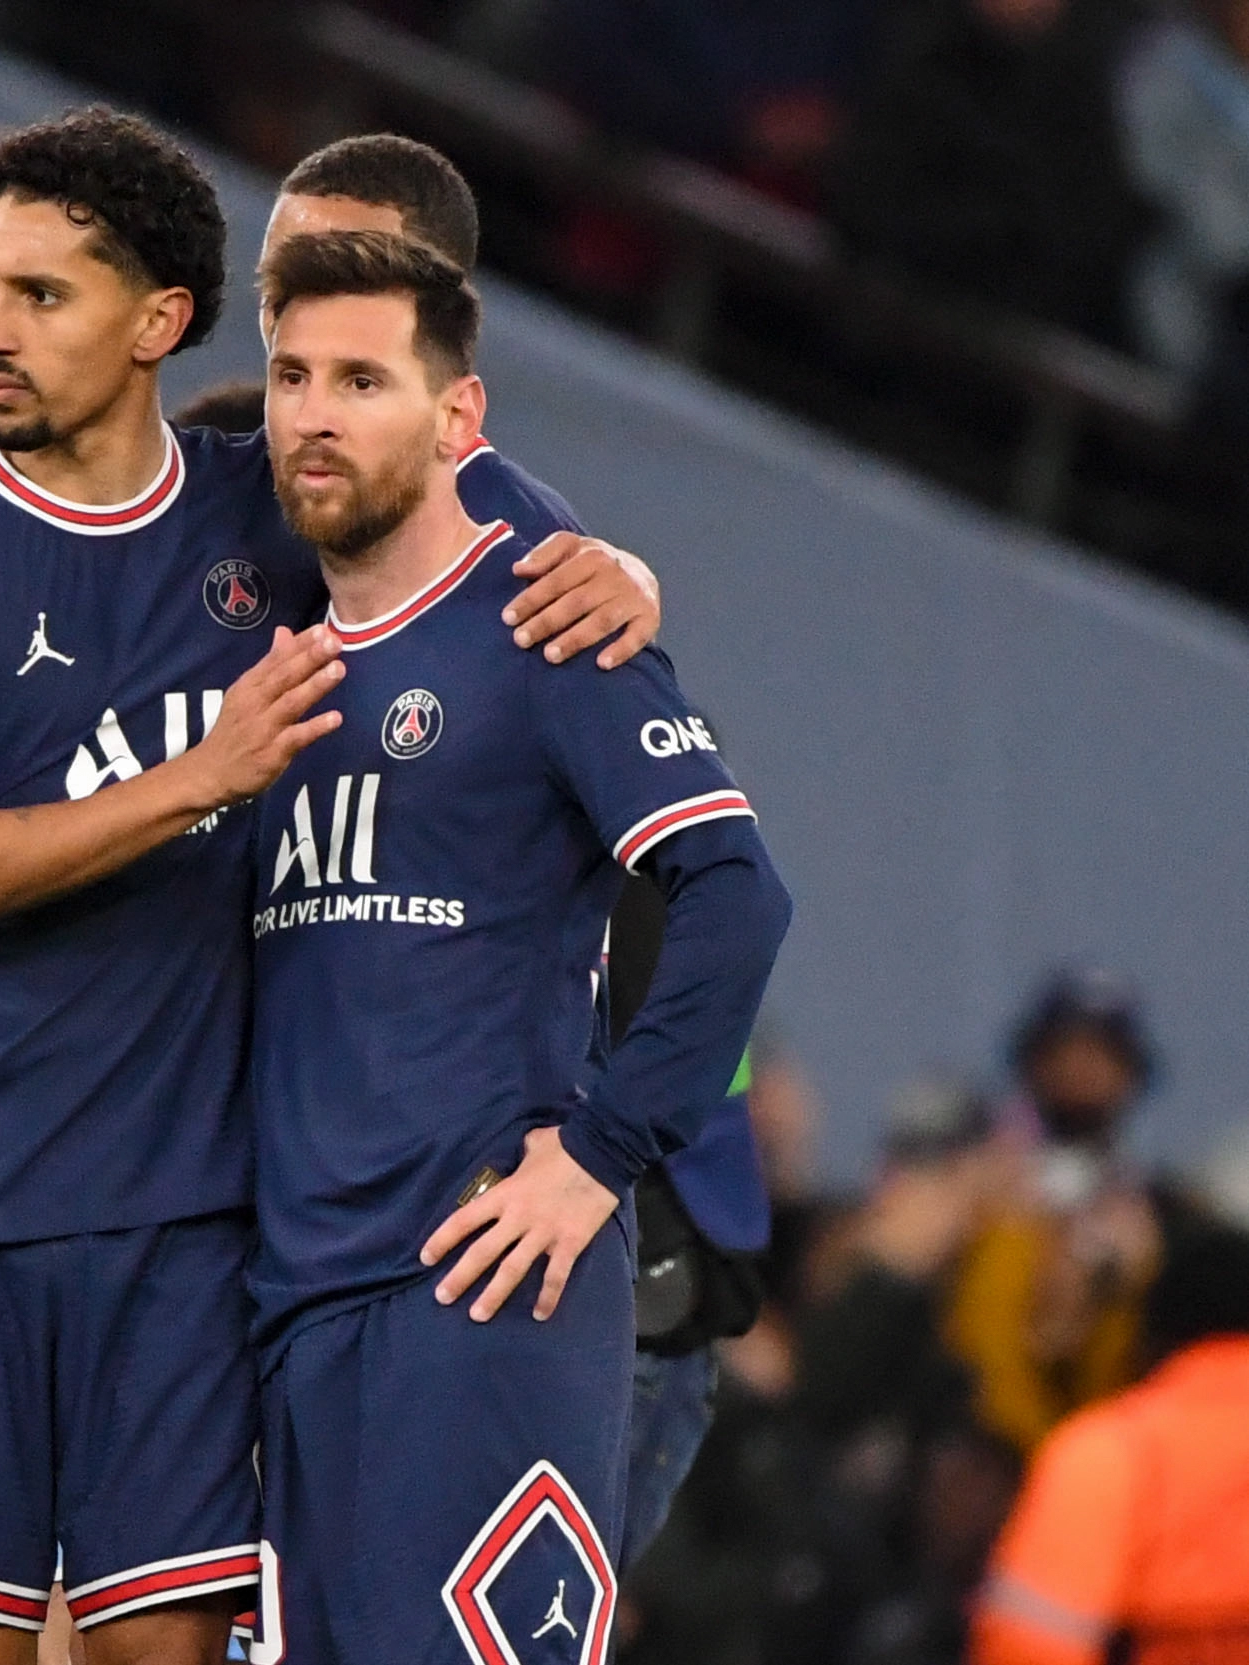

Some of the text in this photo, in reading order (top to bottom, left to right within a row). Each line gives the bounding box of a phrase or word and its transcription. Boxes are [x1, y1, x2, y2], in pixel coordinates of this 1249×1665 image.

[210, 563, 253, 584] PARIS
[397, 693, 436, 712] PARIS
[279, 897, 321, 929] LIVE
[323, 894, 465, 927] LIMITLESS
